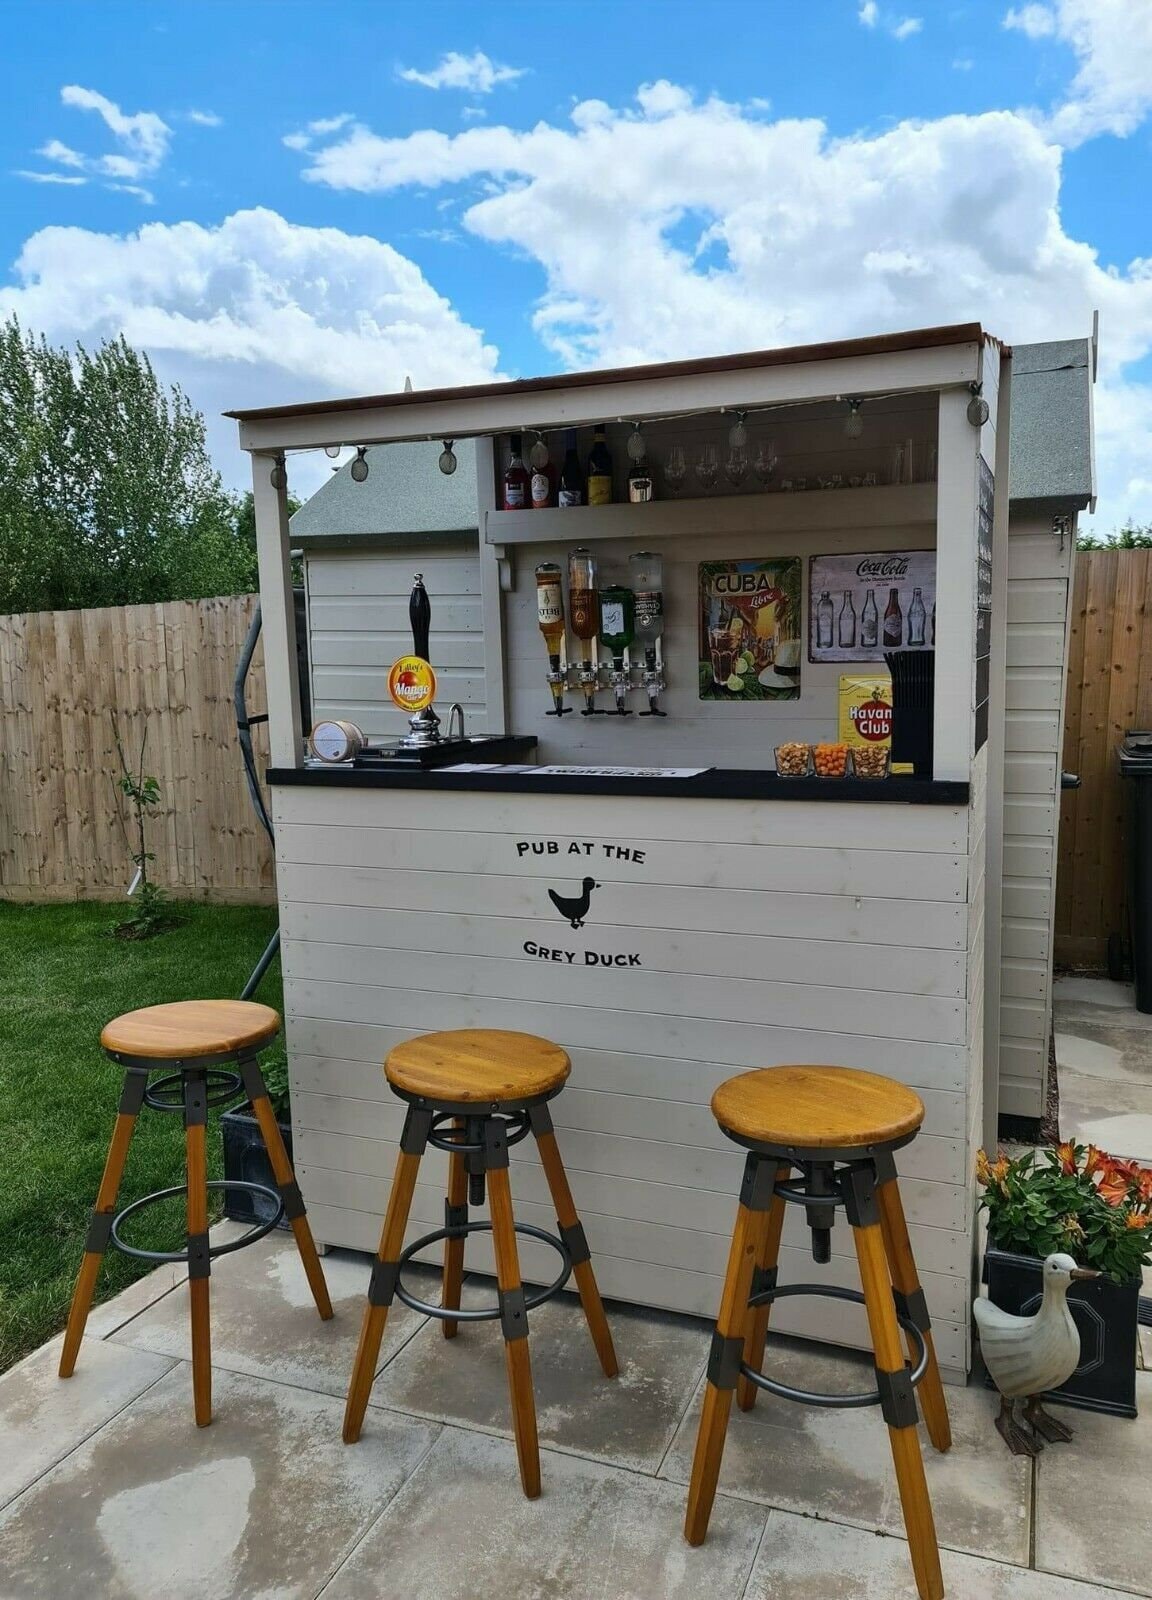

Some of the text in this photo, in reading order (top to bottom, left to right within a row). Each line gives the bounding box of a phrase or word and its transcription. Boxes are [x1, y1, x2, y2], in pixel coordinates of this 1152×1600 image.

[856, 557, 910, 576] Coca-Cola
[715, 573, 771, 593] CUBA
[750, 591, 774, 609] Libre
[395, 682, 429, 699] Mango
[849, 705, 892, 720] Havan
[859, 720, 890, 734] Club
[517, 841, 646, 864] PUB AT THE
[523, 941, 642, 967] GREY DUCK
